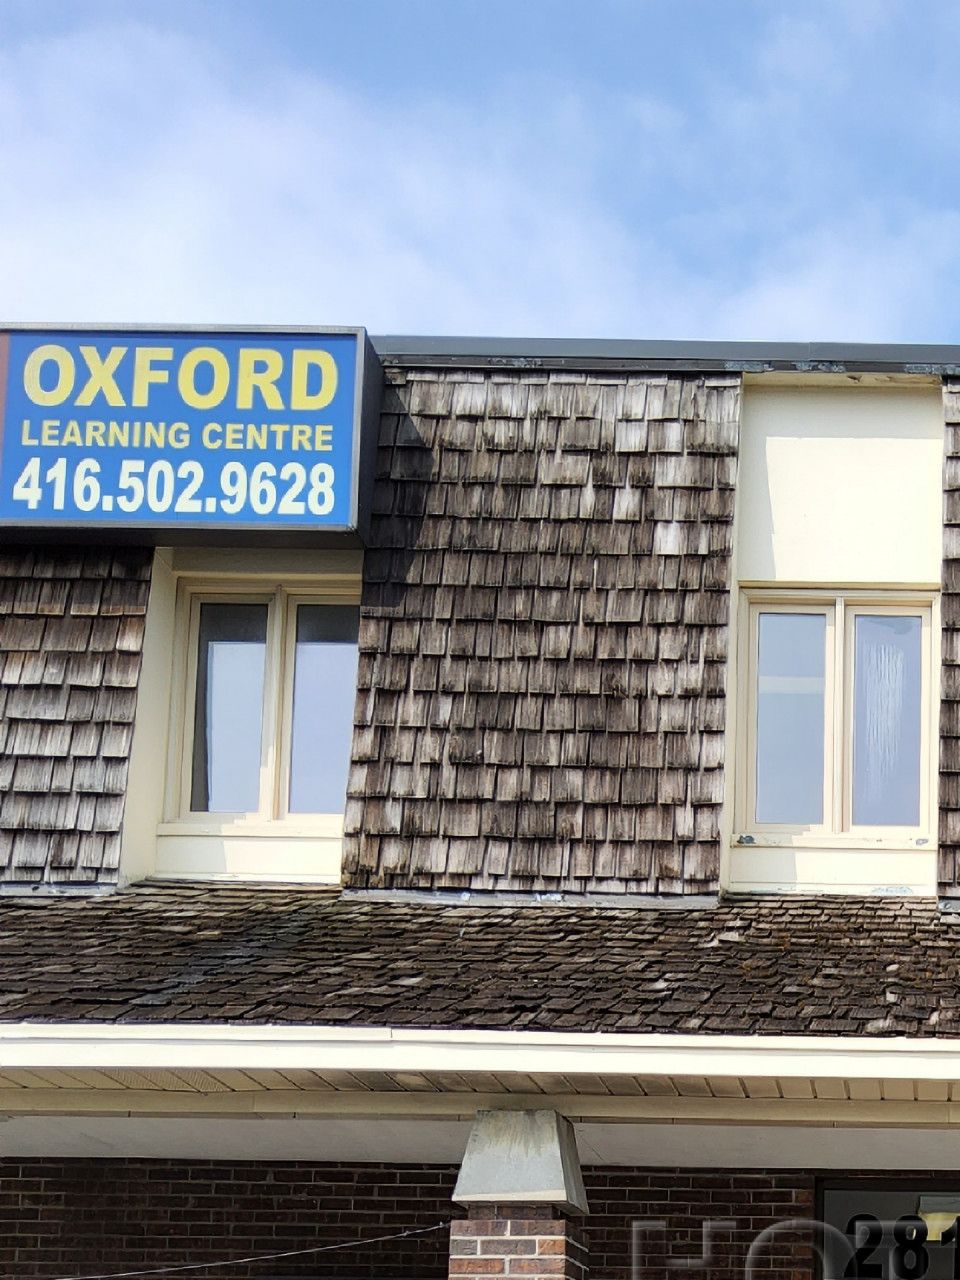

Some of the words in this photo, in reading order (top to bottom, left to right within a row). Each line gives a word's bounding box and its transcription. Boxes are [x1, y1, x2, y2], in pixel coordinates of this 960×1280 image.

[23, 344, 339, 410] OXFORD
[21, 419, 191, 449] LEARNING
[202, 424, 333, 451] CENTRE
[12, 457, 336, 515] 416.502.9628
